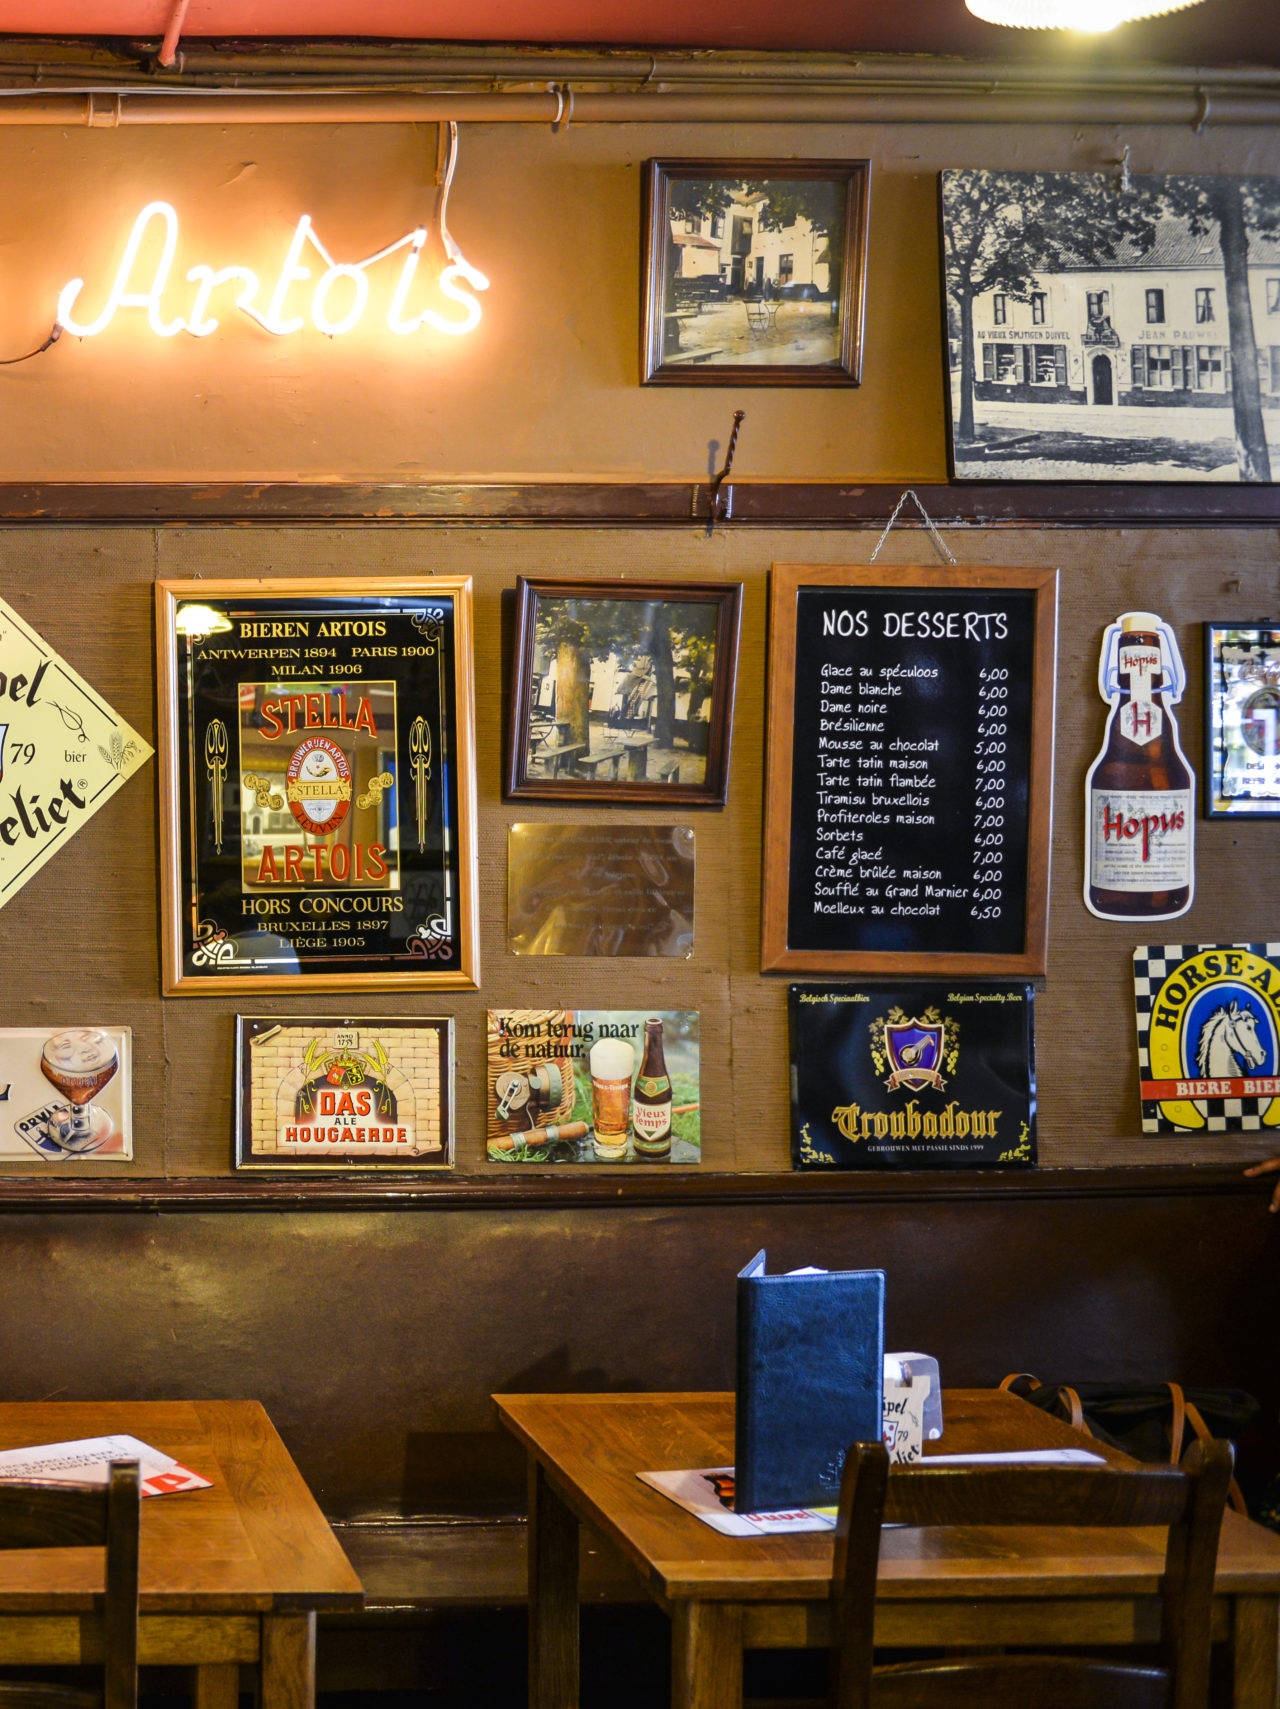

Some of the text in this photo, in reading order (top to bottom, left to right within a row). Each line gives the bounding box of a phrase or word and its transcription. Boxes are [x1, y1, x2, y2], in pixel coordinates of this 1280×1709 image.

[58, 202, 489, 338] Artois
[240, 620, 387, 639] BIEREN ARTOIS
[822, 608, 1008, 642] NOS DESSERTS
[196, 646, 435, 660] ANTWERPEN 1894 PARIS 1900
[271, 664, 362, 676] MILAN 1906
[821, 664, 1009, 682] Glace au spéculoos 6,00
[1124, 654, 1158, 676] Hopus
[821, 682, 1008, 700] Dame blanche 6,00
[258, 692, 378, 740] STELLA
[820, 700, 1008, 718] Dame noire 6,00
[820, 717, 1007, 736] Brésilienne 6,00
[1132, 701, 1152, 738] H
[10, 743, 36, 766] 79
[819, 738, 1006, 756] Mousse au chocolat 5,00
[64, 750, 88, 764] bier
[328, 747, 350, 777] ARTOIS
[817, 755, 1006, 774] Tarte tatin maison 6,00
[296, 786, 344, 796] STELLA
[816, 773, 1006, 792] Tarte tatin flambée 7,00
[816, 791, 1005, 810] Tiramisu bruxellois 6,00
[296, 812, 344, 834] LEUVEN
[817, 809, 1004, 828] Profiteroles maison 7,00
[816, 828, 1004, 847] Sorbets 6,00
[1103, 804, 1184, 862] Hopus
[256, 842, 388, 884] ARTOIS
[816, 846, 1004, 866] Café glacé 7,00
[815, 866, 1002, 884] Crème brûlée maison 6,00
[814, 882, 1002, 902] Soufflé au Grand Marnier 6,00
[242, 896, 404, 916] HORS CONCOURS
[814, 902, 1002, 920] Moelleux au chocolat 6,50
[258, 920, 390, 933] BRUXELLES 1897
[278, 936, 366, 949] LIÈGE 1905
[1155, 954, 1280, 1032] HORSE-A
[499, 1017, 640, 1042] Kom terug naar
[499, 1039, 587, 1058] de natuur.
[1176, 1080, 1232, 1096] BIERE
[320, 1091, 372, 1116] DAS
[636, 1106, 666, 1118] Vieux
[334, 1117, 357, 1126] ALE
[634, 1116, 668, 1128] Temps
[831, 1099, 1003, 1144] Troubadour
[285, 1126, 408, 1143] HOUGAERDE
[898, 1430, 909, 1442] 79
